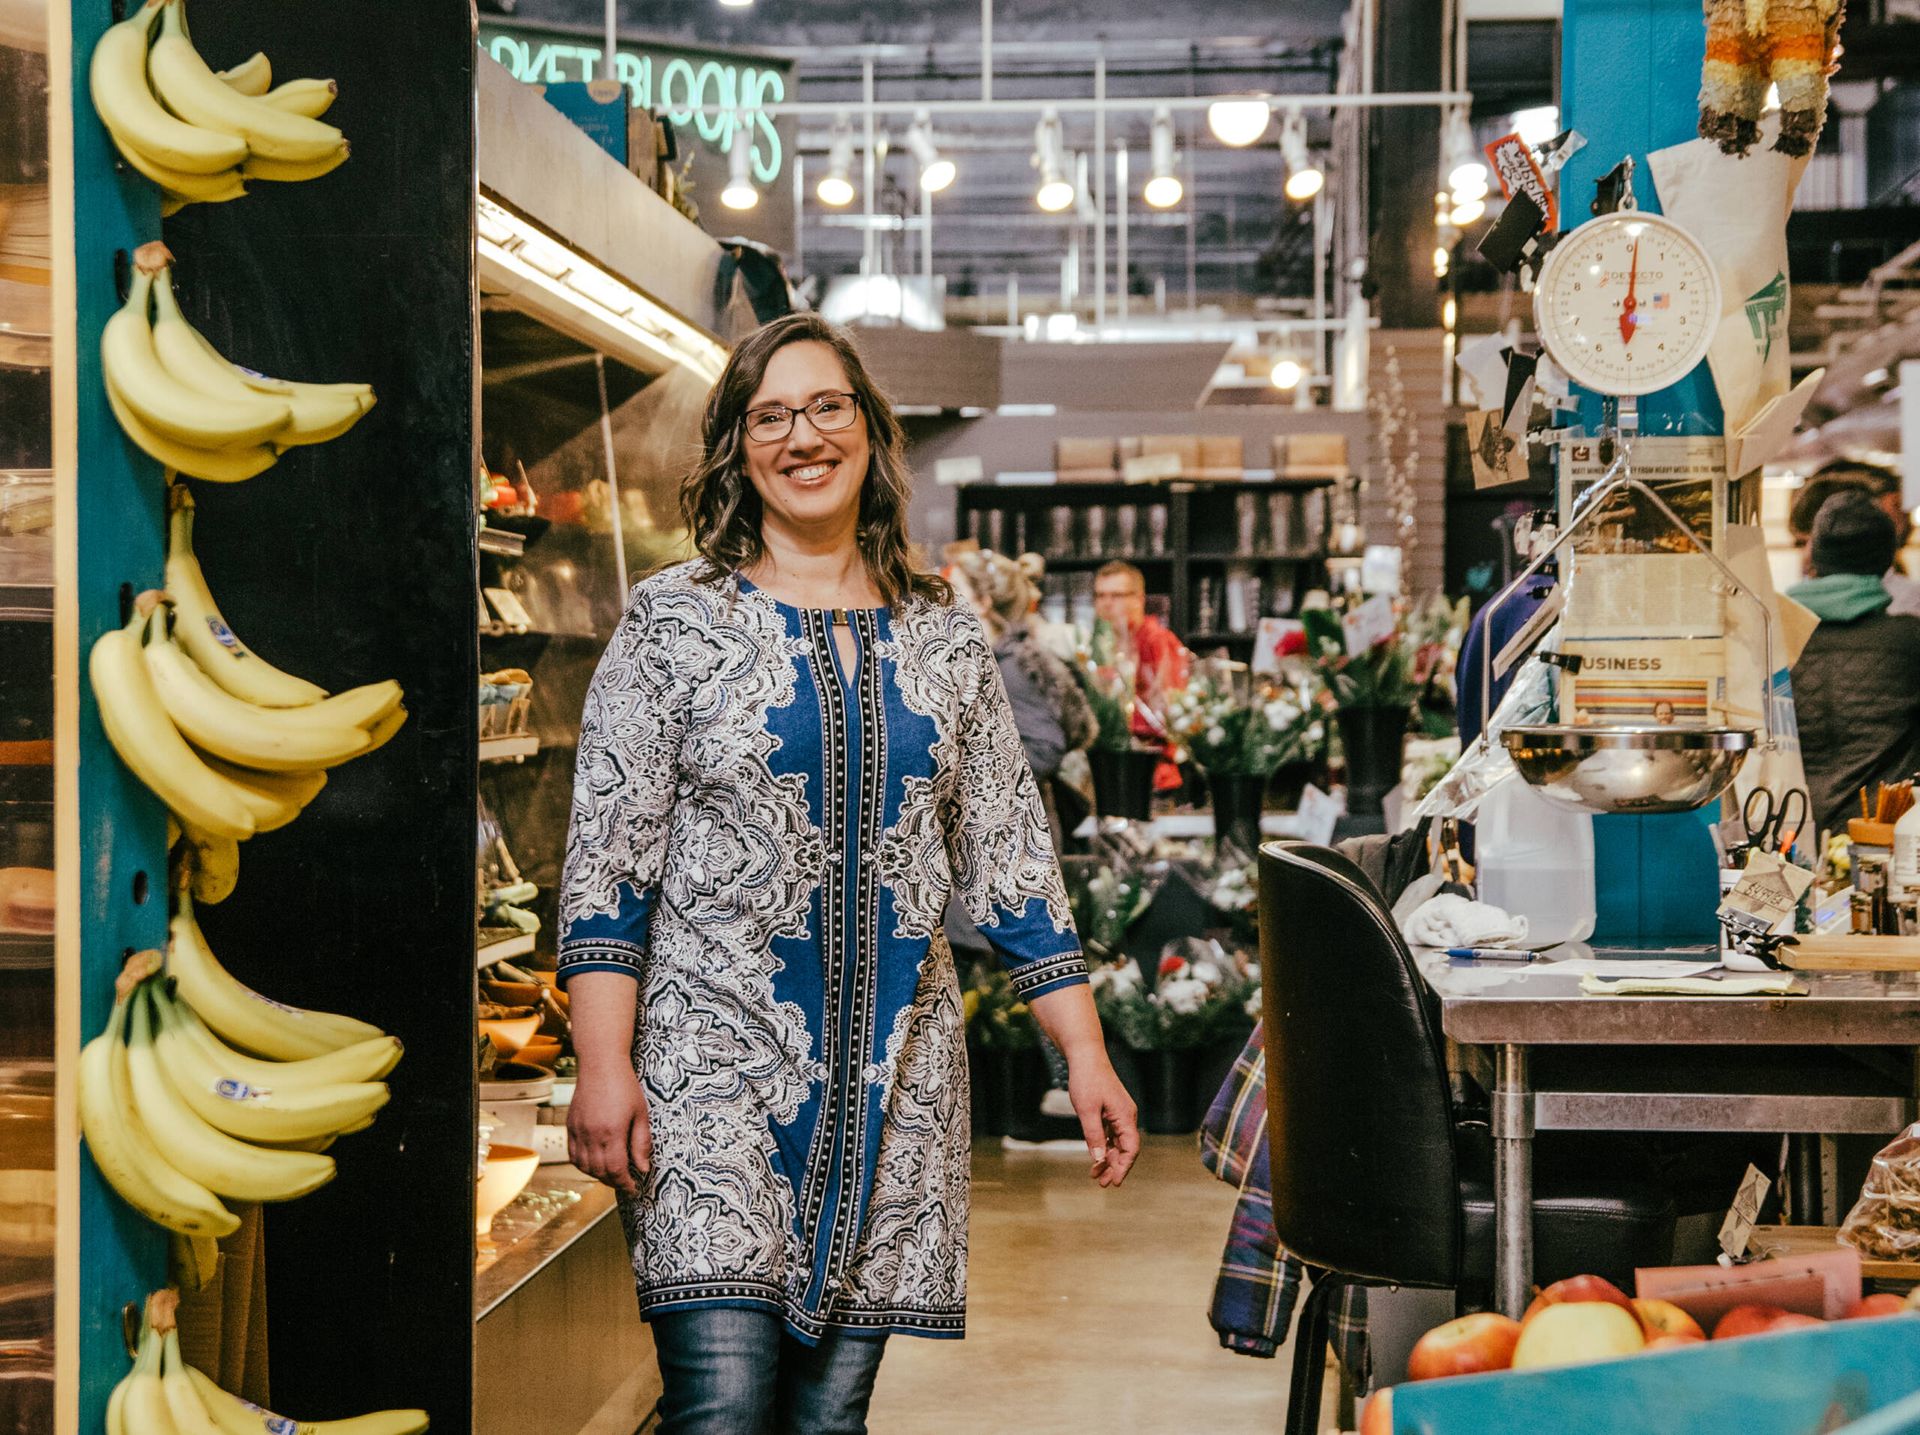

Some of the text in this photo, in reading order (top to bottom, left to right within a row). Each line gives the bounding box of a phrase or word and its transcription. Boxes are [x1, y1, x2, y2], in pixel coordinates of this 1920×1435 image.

[614, 52, 785, 183] BLOOMS
[1626, 244, 1634, 252] 0
[1596, 253, 1603, 261] 9
[1574, 283, 1581, 291] 8
[1680, 282, 1686, 290] 2
[1574, 318, 1580, 326] 7
[1679, 316, 1686, 324] 3
[1657, 343, 1664, 351] 4
[1626, 353, 1633, 362] 5
[1583, 658, 1662, 671] USINESS
